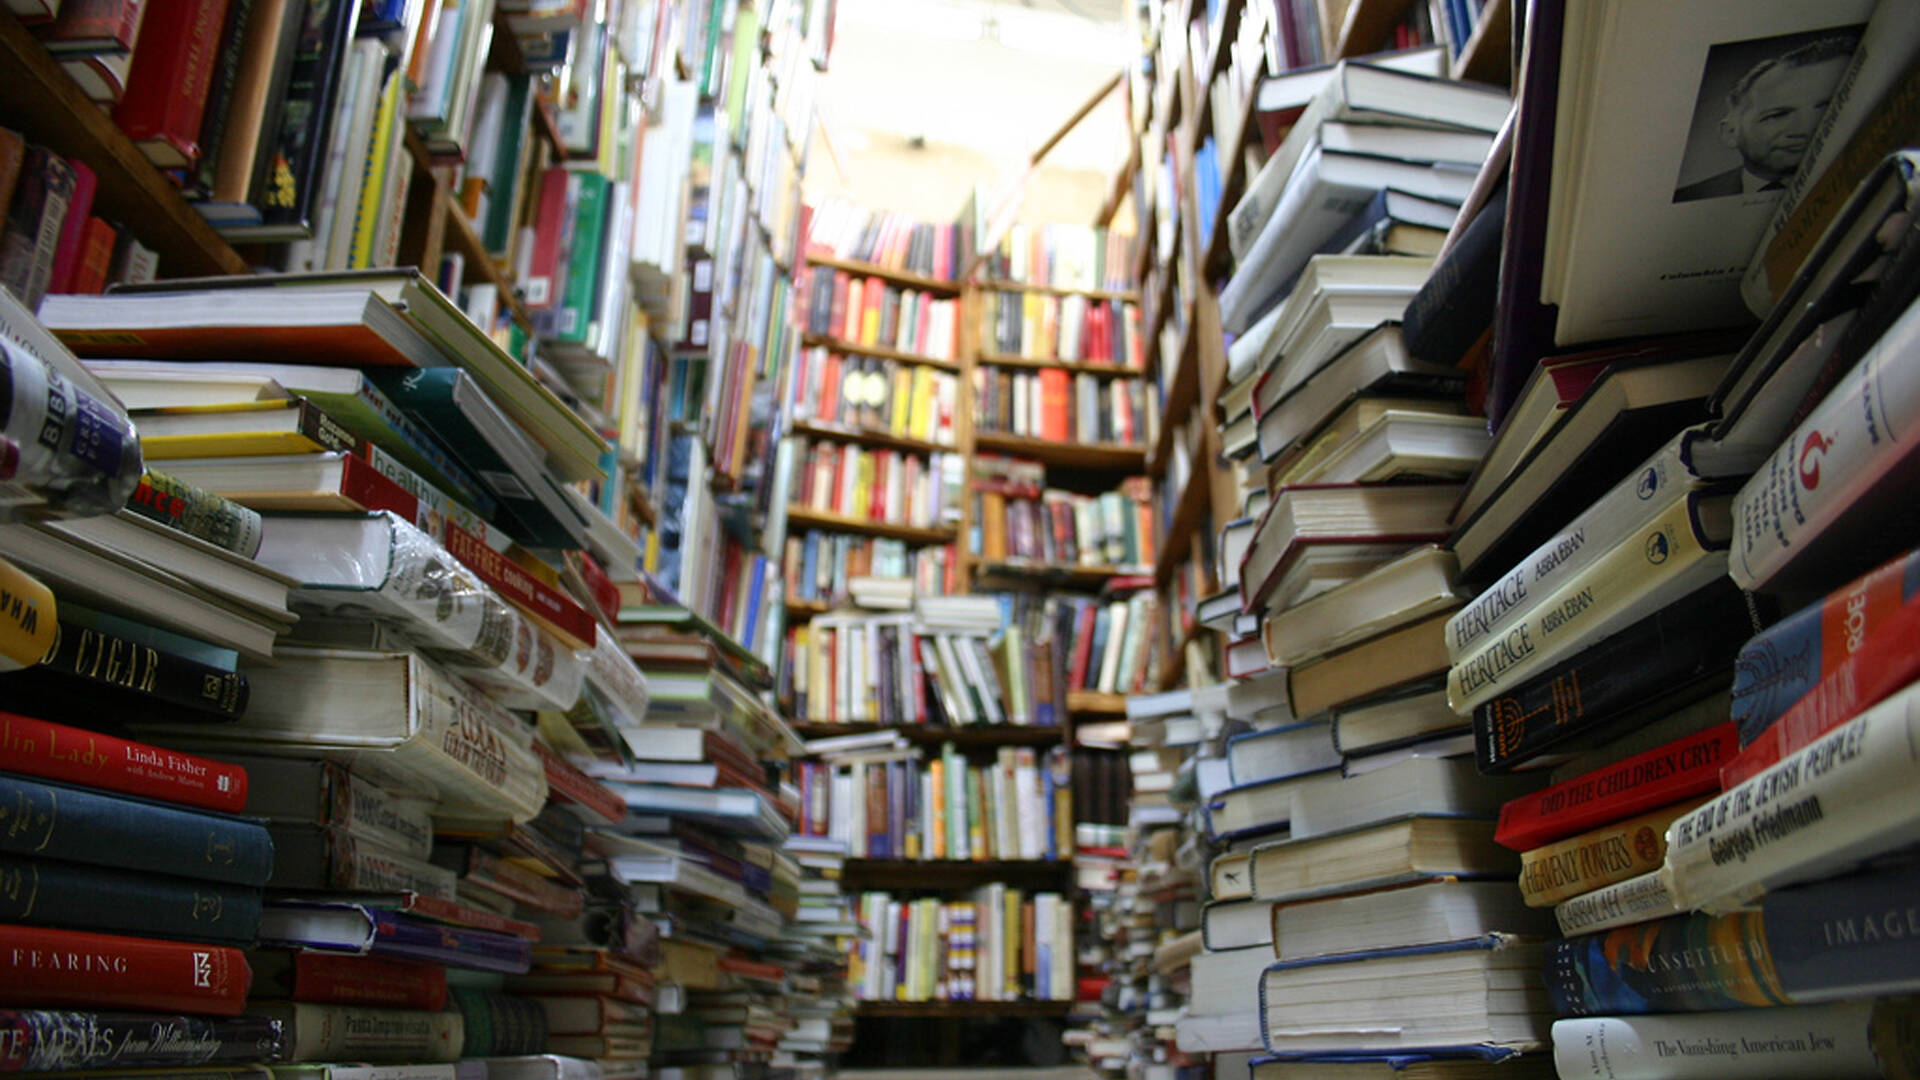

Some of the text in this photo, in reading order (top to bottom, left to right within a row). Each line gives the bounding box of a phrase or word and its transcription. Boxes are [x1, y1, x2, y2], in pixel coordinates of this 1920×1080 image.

[374, 448, 439, 508] healthy
[1455, 572, 1528, 649] HERITAGE
[1534, 554, 1561, 583] ABBA
[75, 628, 159, 692] CIGAR
[1459, 623, 1535, 697] HERITAGE
[1541, 608, 1569, 638] ABBA
[50, 729, 109, 768] Lady
[126, 746, 207, 778] Linda Fisher
[1540, 738, 1722, 817] DID THE CHILDREN CRY?
[1696, 806, 1716, 838] END
[1716, 797, 1732, 828] OF
[1732, 784, 1753, 819] THE
[1755, 760, 1800, 808] JEWISH
[1708, 794, 1823, 867] Georges Friedmann
[13, 949, 128, 974] FEARING
[1647, 940, 1764, 974] UNSETTLED
[31, 1026, 114, 1062] MEALS
[1654, 1032, 1836, 1060] The Vanishing American Jew
